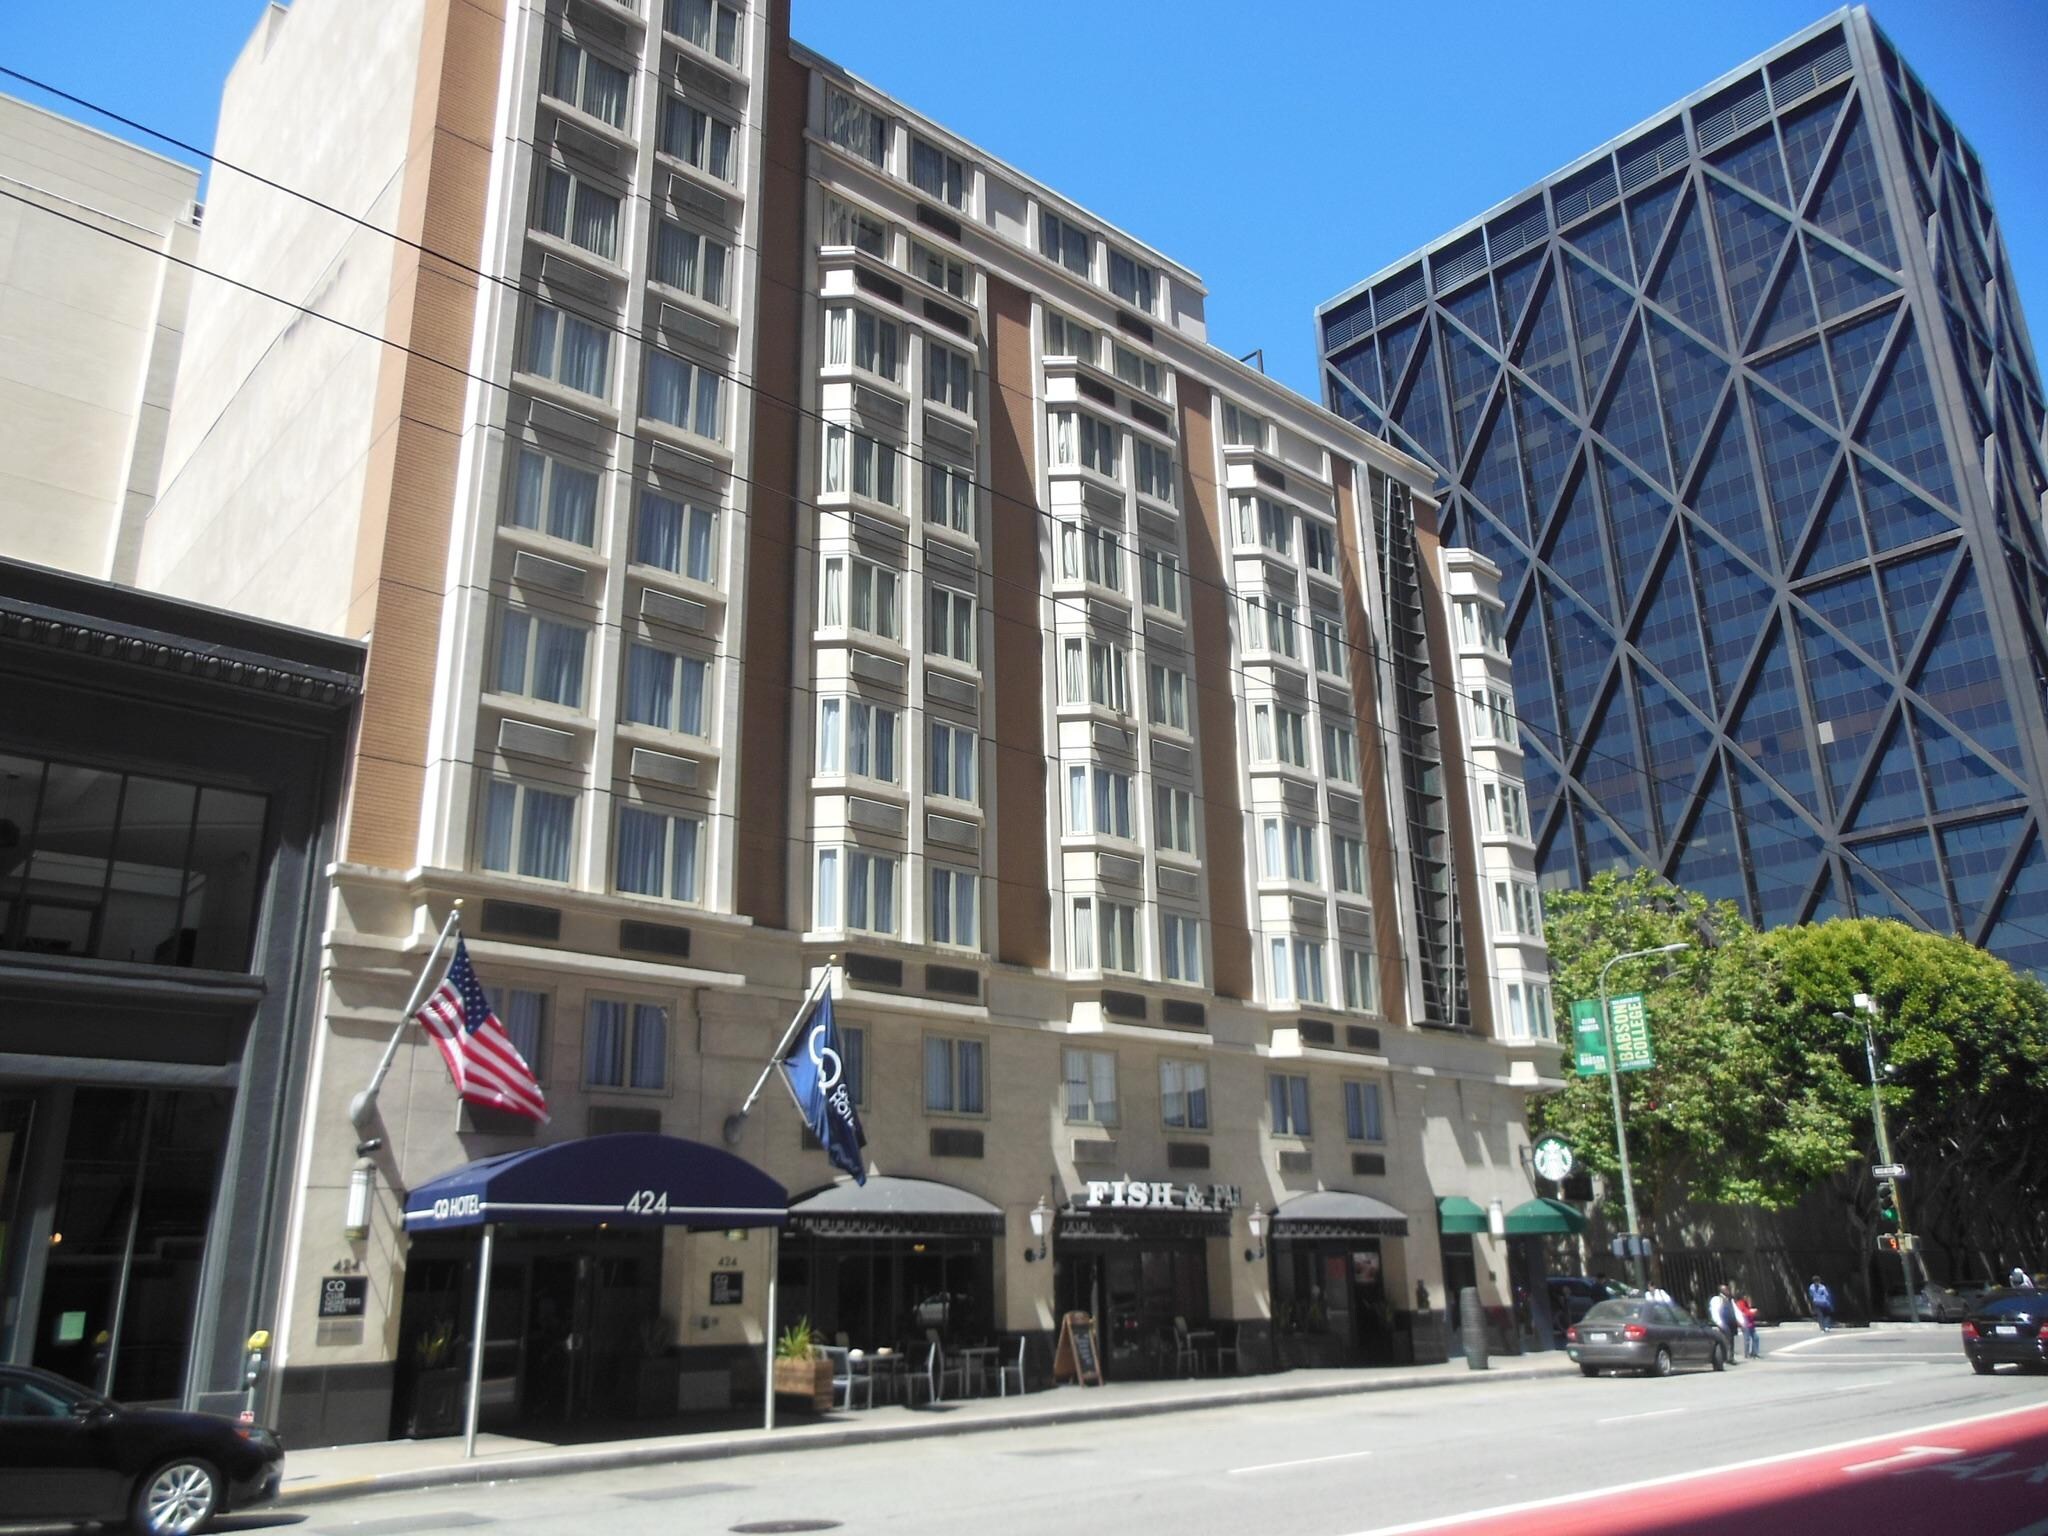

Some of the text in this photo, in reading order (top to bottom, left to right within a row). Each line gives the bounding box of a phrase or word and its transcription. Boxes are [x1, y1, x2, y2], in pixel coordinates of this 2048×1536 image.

[1613, 1003, 1634, 1061] BABSON
[1628, 1002, 1649, 1059] COLLEGE
[434, 1194, 480, 1220] CQ HOTEL
[626, 1190, 668, 1215] 424
[1086, 1181, 1173, 1208] FISH
[1184, 1183, 1206, 1210] &
[333, 1258, 361, 1274] 424
[718, 1256, 737, 1267] 424
[326, 1280, 346, 1292] CQ
